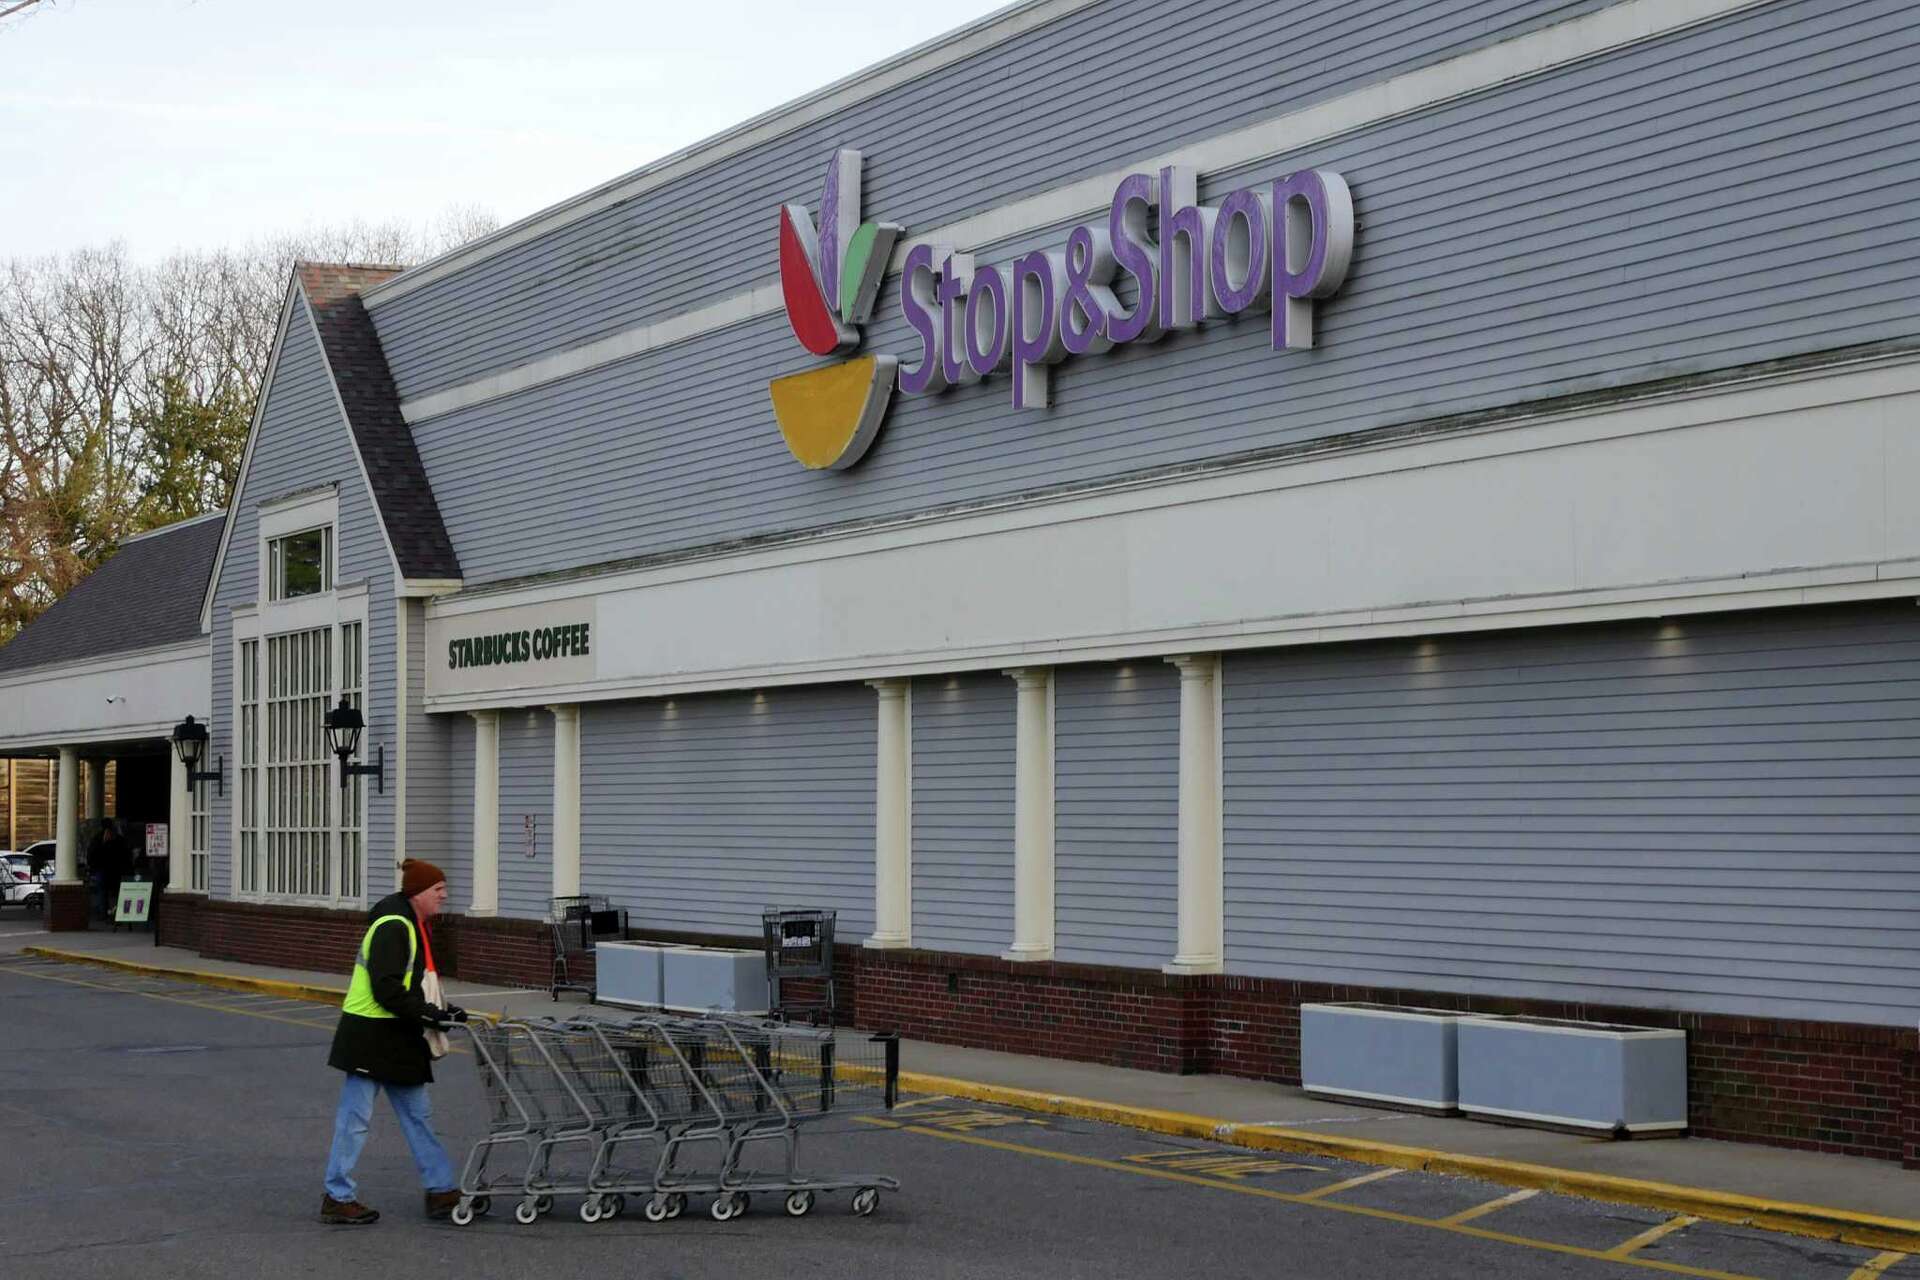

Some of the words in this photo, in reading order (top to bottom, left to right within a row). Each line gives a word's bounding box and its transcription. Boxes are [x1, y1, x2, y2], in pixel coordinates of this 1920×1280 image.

[900, 165, 1354, 409] Stop&Shop
[449, 630, 530, 669] STARBUCKS
[532, 623, 590, 660] COFFEE
